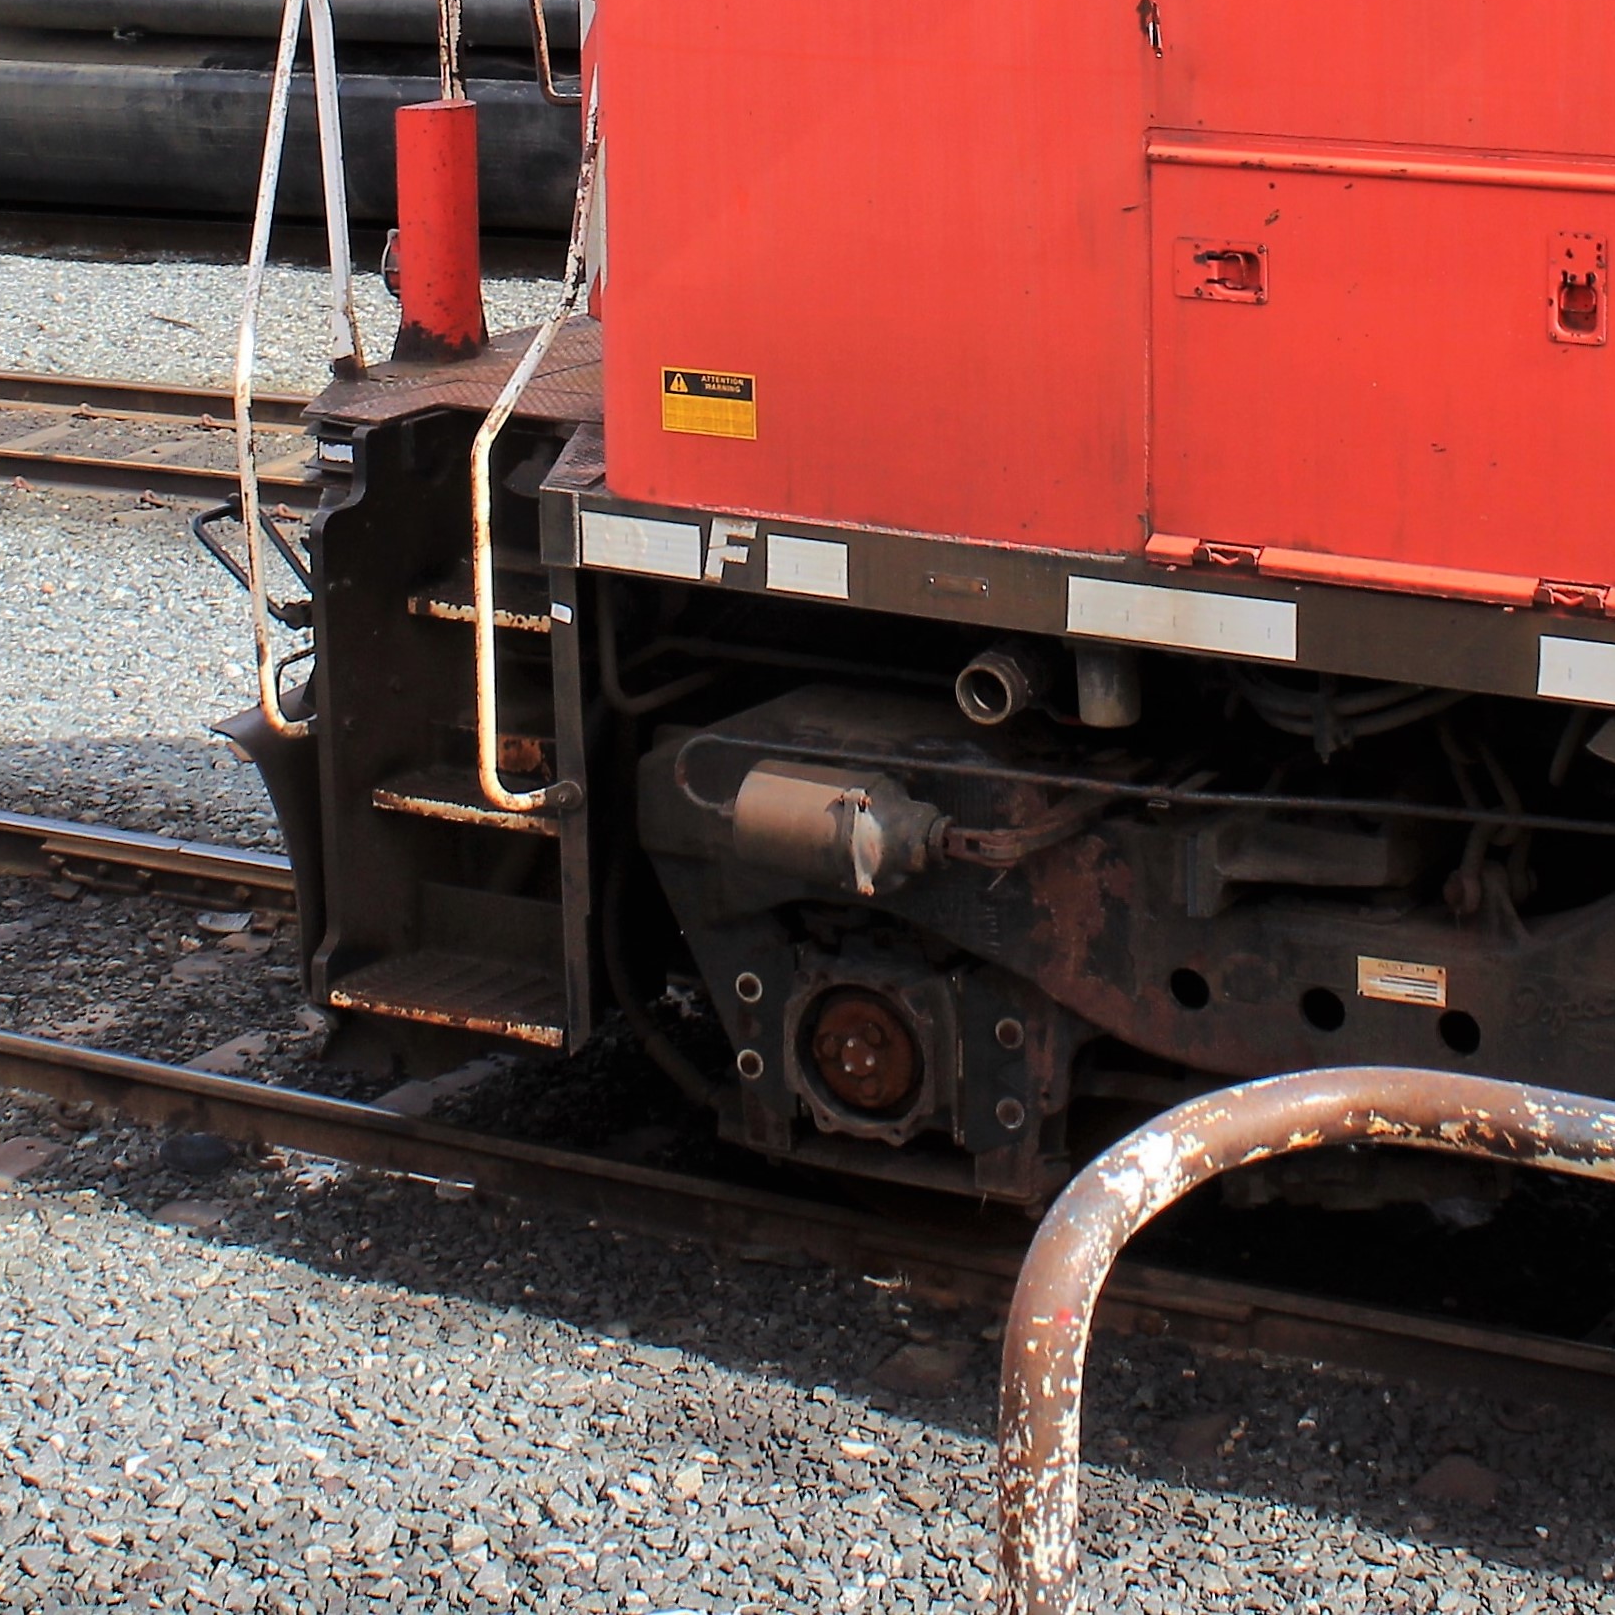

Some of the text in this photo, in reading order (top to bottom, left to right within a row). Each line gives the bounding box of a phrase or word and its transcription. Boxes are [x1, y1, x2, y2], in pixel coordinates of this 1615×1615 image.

[701, 375, 744, 386] ATTENTION
[705, 383, 741, 393] WARNING
[704, 516, 758, 583] F
